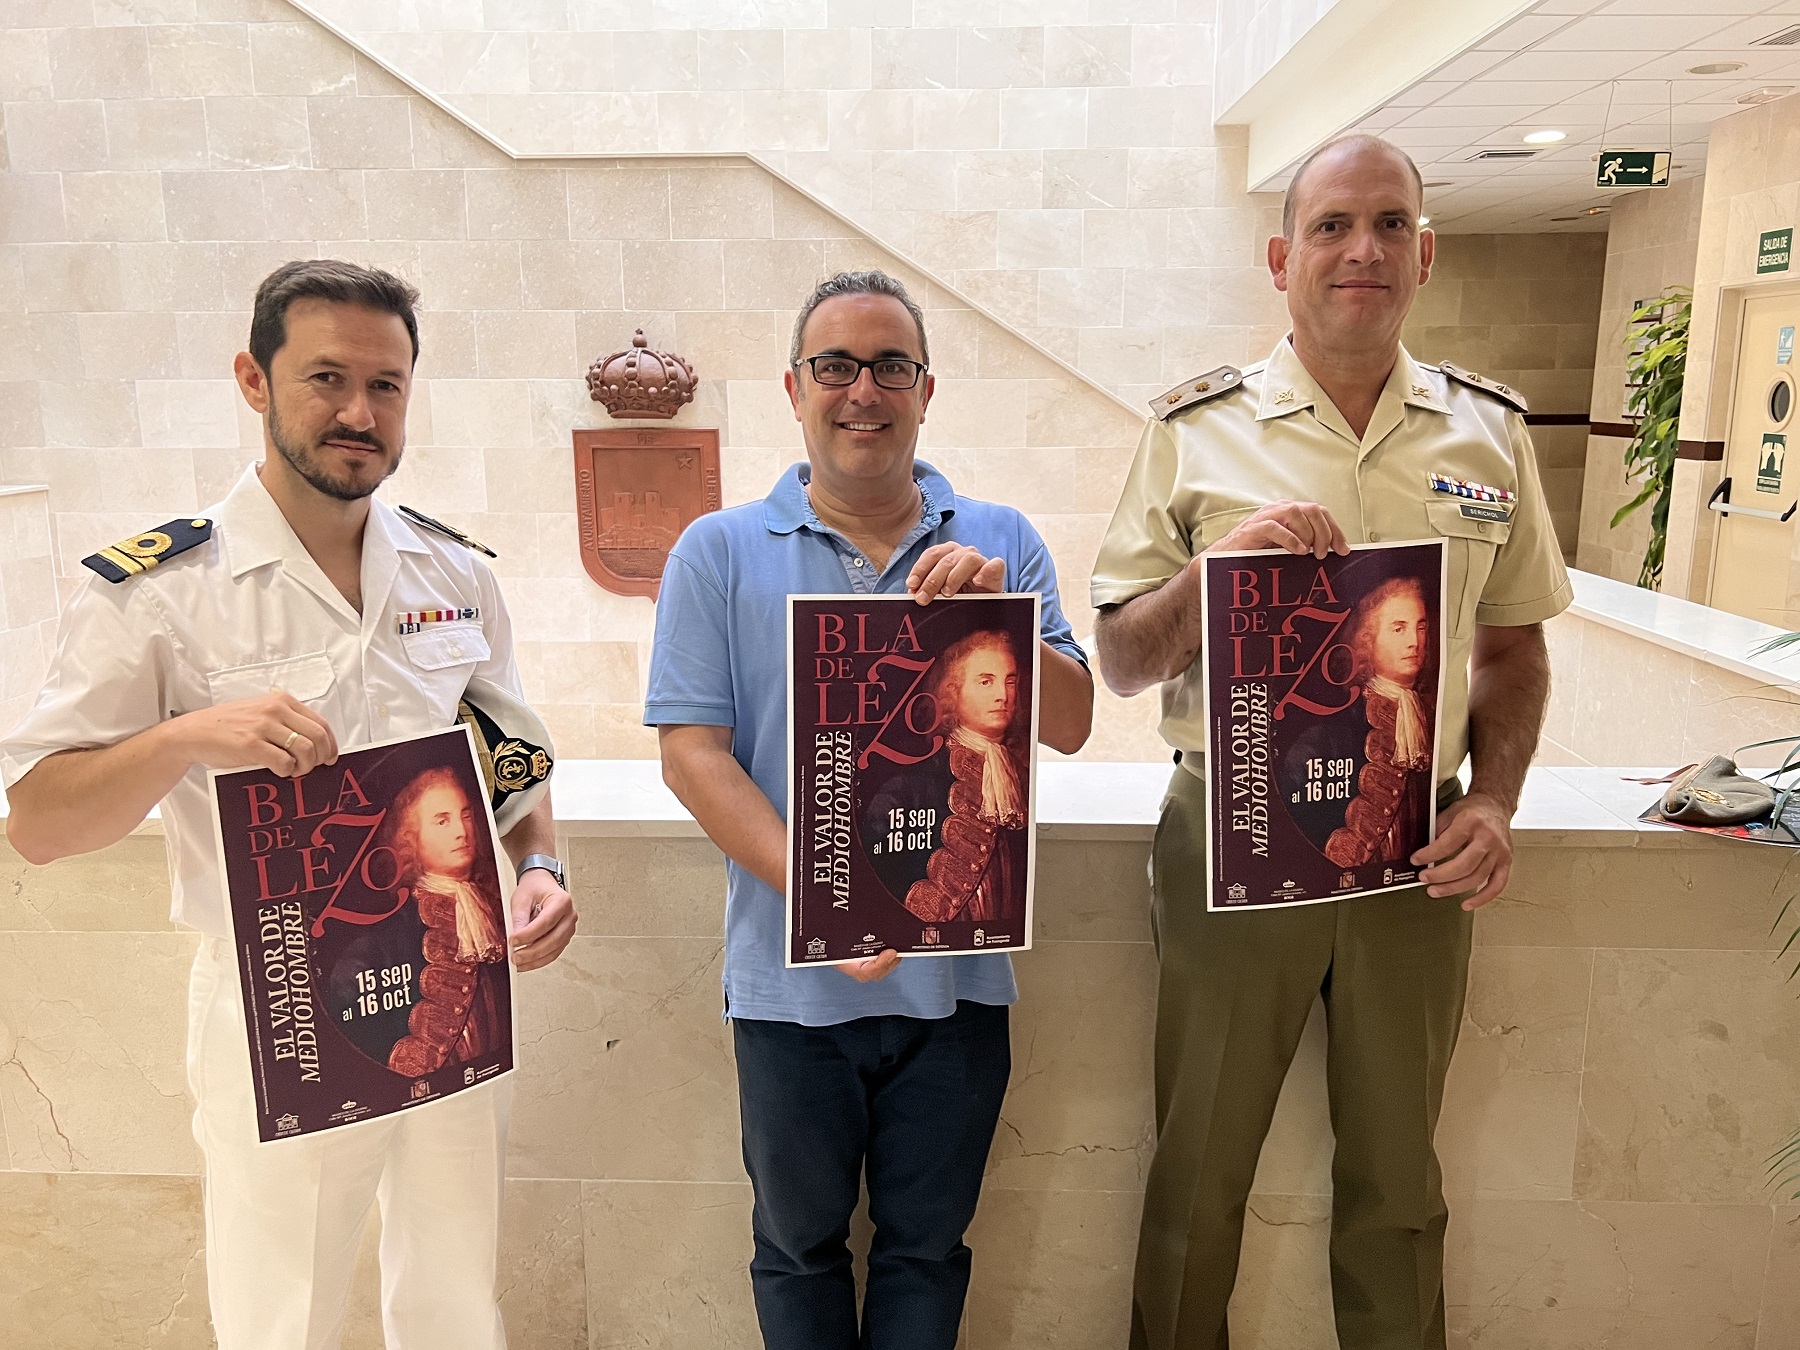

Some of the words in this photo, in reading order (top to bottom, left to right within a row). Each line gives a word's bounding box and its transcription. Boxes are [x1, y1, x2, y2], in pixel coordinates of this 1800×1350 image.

[1759, 252, 1788, 267] EMERGENCIA
[1763, 238, 1780, 251] SALIDA
[1780, 236, 1788, 248] DE
[579, 469, 594, 550] AYUNTAMIENTO
[1228, 566, 1338, 609] BLA
[814, 613, 923, 654] BLA
[1229, 611, 1268, 633] DE
[814, 657, 855, 680] DE
[1229, 606, 1361, 721] LEZO
[814, 654, 944, 771] LEZO
[1231, 684, 1249, 719] DE
[815, 731, 833, 767] DE
[1232, 721, 1250, 801] VALOR
[1251, 682, 1268, 858] MEDIOHOMBRE
[1305, 758, 1323, 780] 15
[1327, 758, 1354, 779] sep
[242, 768, 372, 829] BLA
[1291, 790, 1300, 804] al
[1304, 780, 1323, 802] 16
[1326, 778, 1351, 800] oct
[814, 770, 833, 852] VALOR
[833, 730, 852, 912] MEDIOHOMBRE
[888, 807, 905, 830] 15
[908, 809, 936, 829] sep
[1233, 802, 1250, 832] EL
[248, 824, 297, 854] DE
[873, 841, 882, 855] al
[886, 830, 904, 853] 16
[907, 828, 933, 851] oct
[253, 808, 410, 939] LEZO
[814, 854, 832, 884] EL
[258, 905, 283, 944] DE
[263, 944, 293, 1029] VALOR
[281, 901, 321, 1084] MEDIOHOMBRE
[355, 969, 377, 994] 15
[380, 963, 412, 989] sep
[342, 1007, 353, 1022] al
[356, 992, 379, 1017] 16
[382, 982, 412, 1011] oct
[273, 1029, 297, 1062] EL
